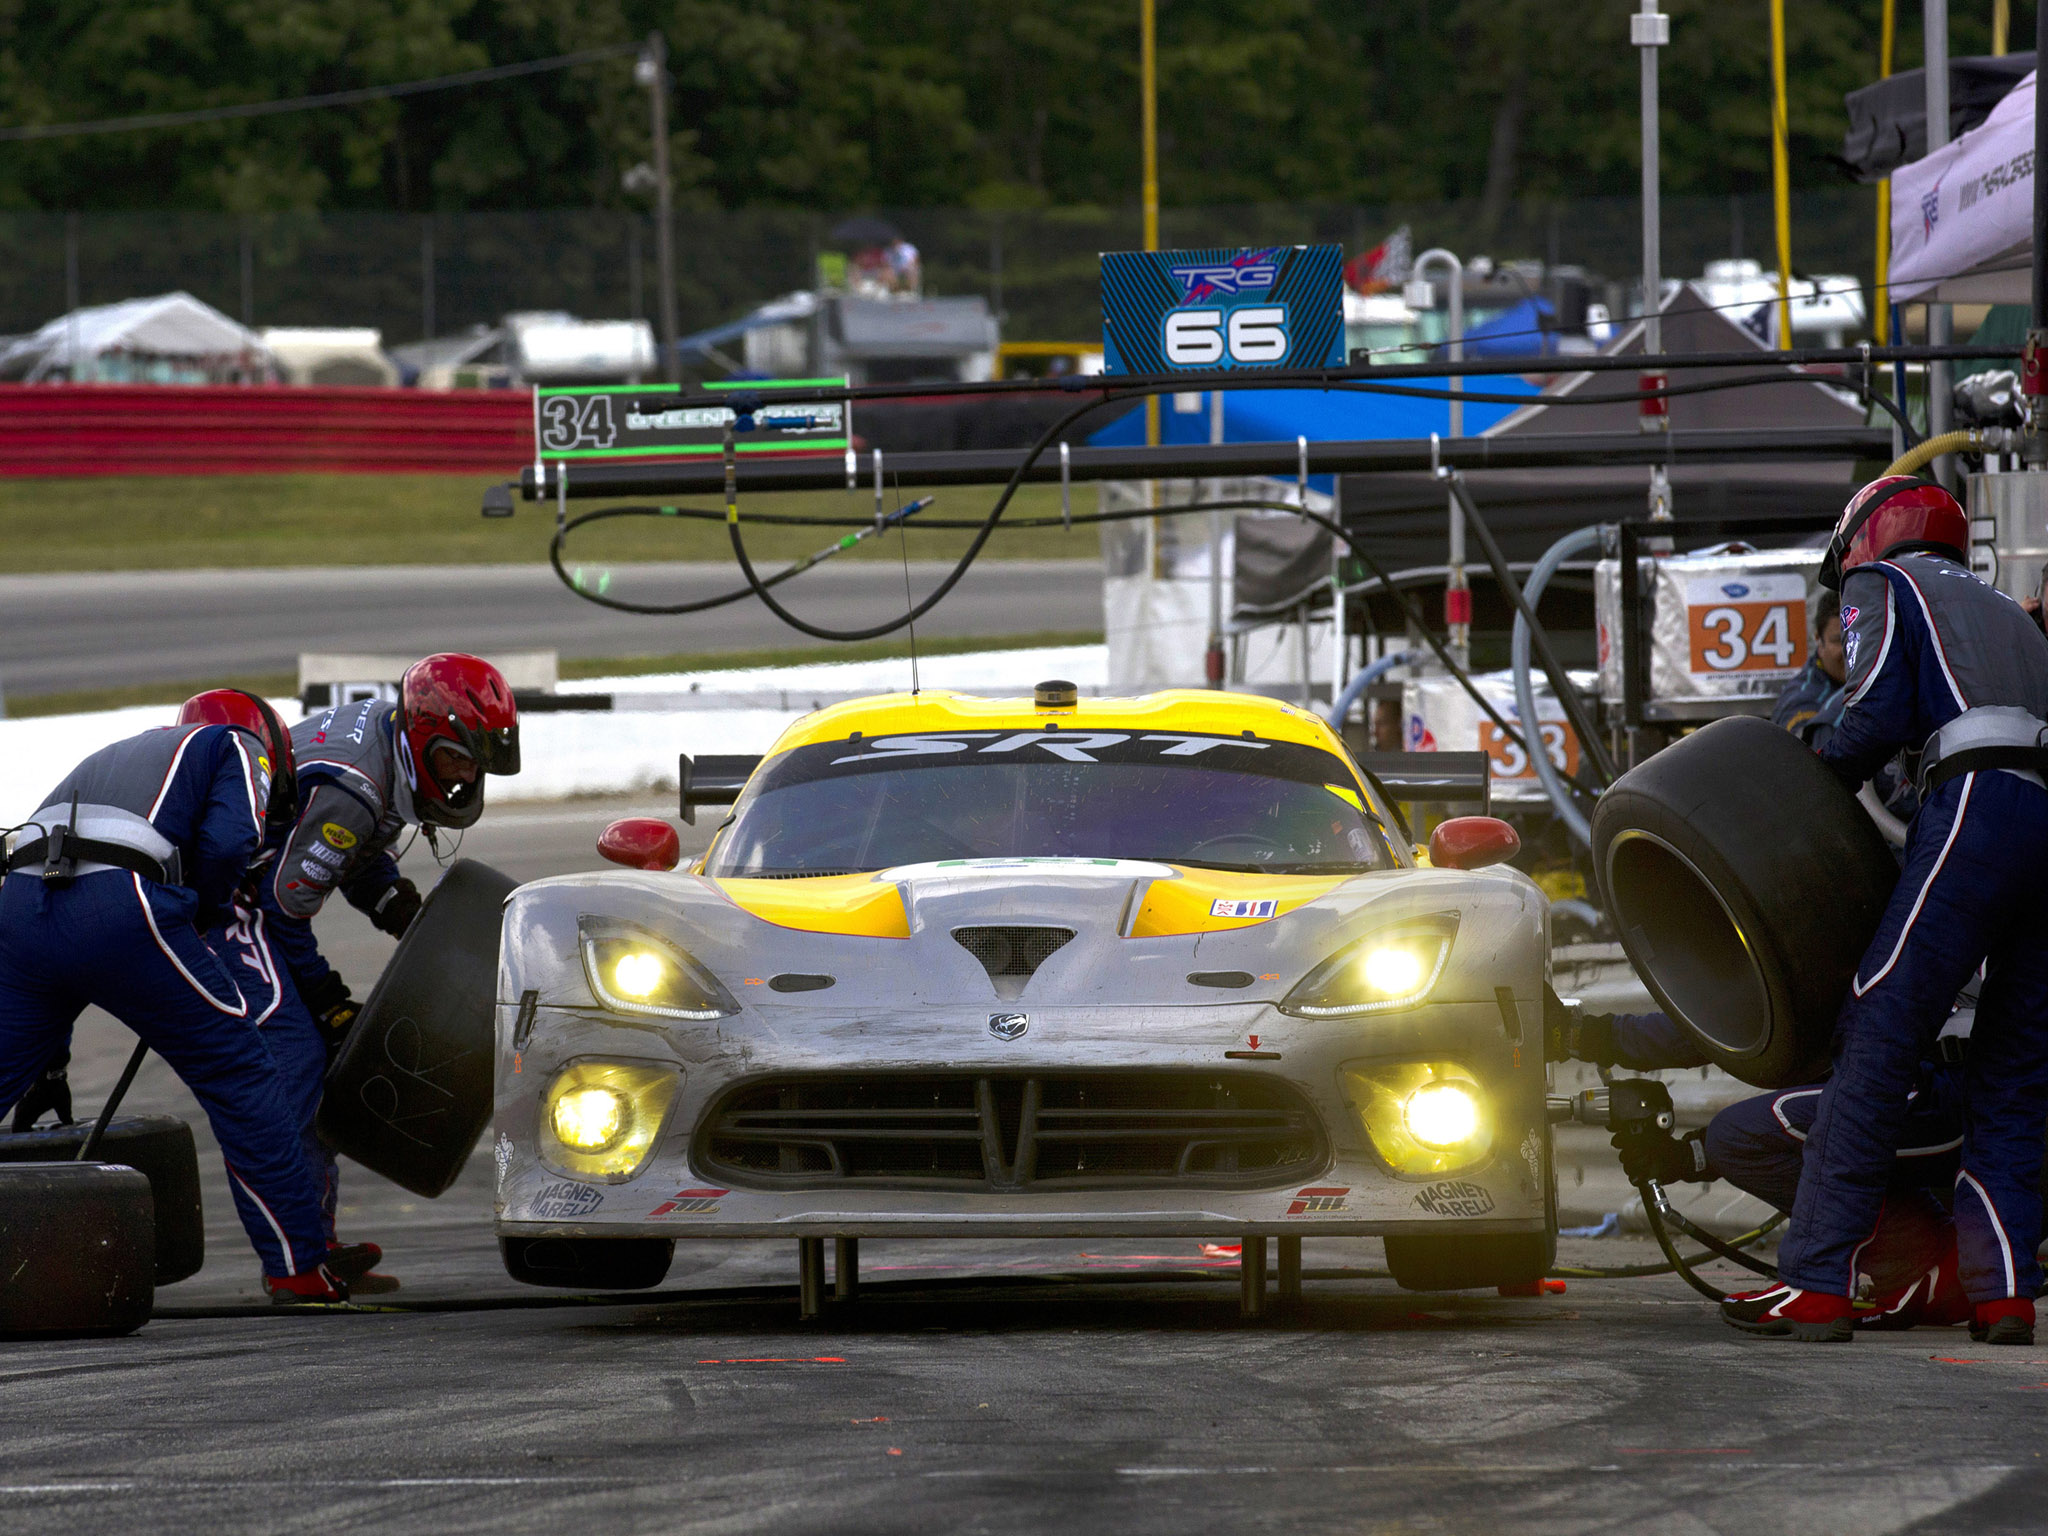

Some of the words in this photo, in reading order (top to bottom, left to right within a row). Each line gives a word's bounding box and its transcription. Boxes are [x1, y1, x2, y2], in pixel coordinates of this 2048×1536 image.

[1172, 264, 1276, 293] TRG
[1165, 308, 1287, 364] 66
[543, 396, 617, 450] 34
[1703, 606, 1795, 670] 34
[830, 733, 1271, 764] SRT
[530, 1182, 604, 1207] MAGNETI
[530, 1197, 603, 1217] MARELLI
[1415, 1182, 1494, 1206] MAGNETI
[1416, 1196, 1495, 1216] MARELLI
